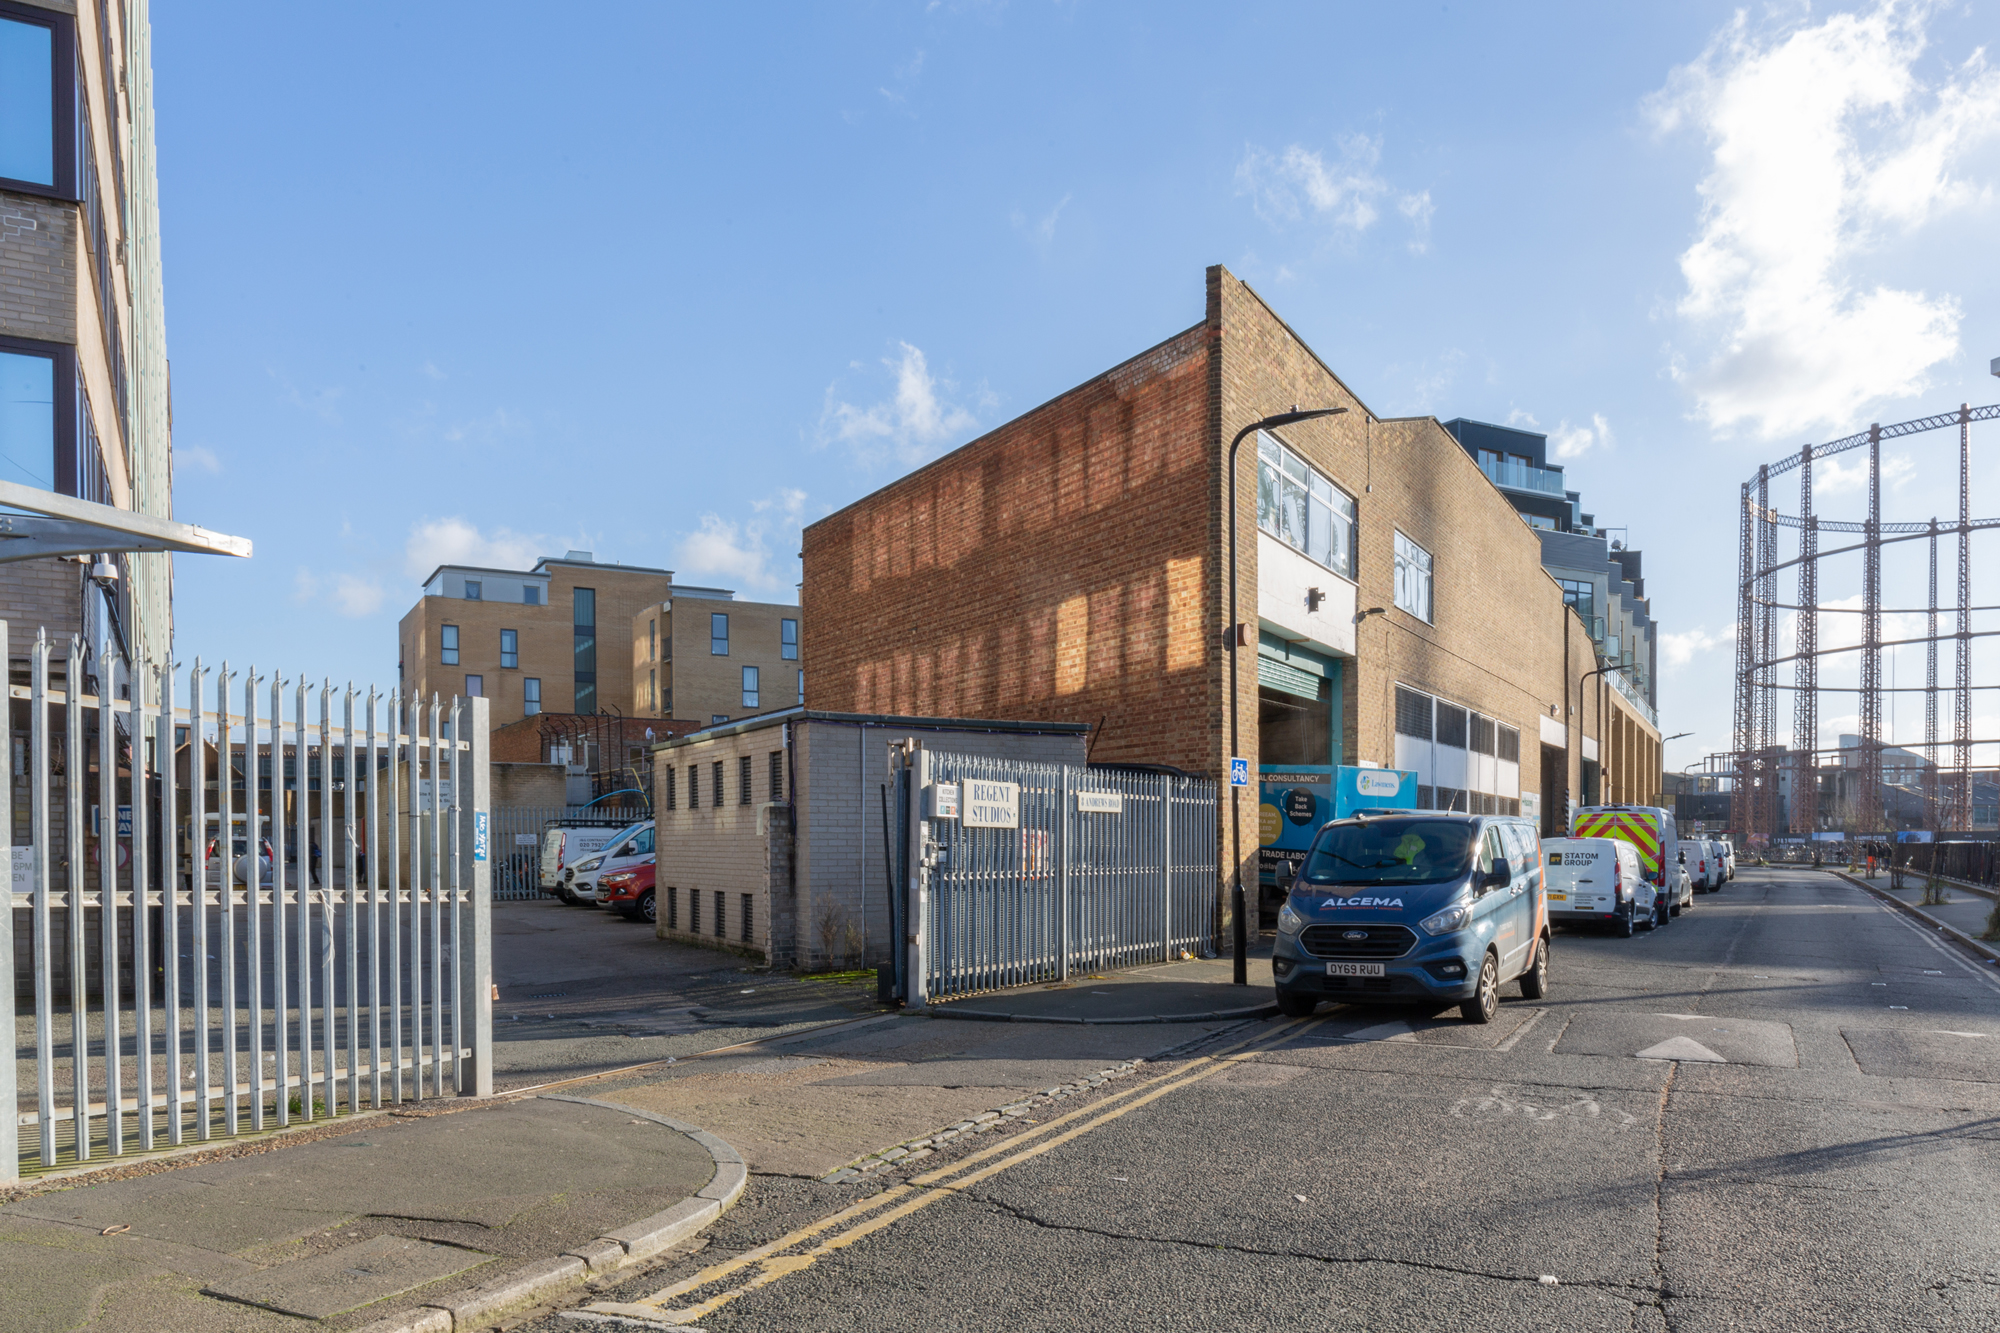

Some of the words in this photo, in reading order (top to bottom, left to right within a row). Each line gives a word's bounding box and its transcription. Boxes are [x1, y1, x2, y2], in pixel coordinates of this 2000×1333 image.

[1268, 774, 1319, 783] CONSULTANCY
[973, 783, 1011, 803] REGENT
[1086, 797, 1107, 808] ANDREWS
[1108, 798, 1120, 808] ROAD
[118, 810, 131, 821] NE
[972, 805, 1012, 824] STUDIOS
[1259, 811, 1277, 819] REEAM,
[1289, 810, 1312, 818] Schemes
[118, 822, 131, 832] AY
[11, 851, 23, 860] BE
[1261, 850, 1285, 859] TRADE
[1286, 852, 1308, 860] LABO
[13, 862, 33, 871] 6PM
[1320, 897, 1404, 907] ALCEMA
[1347, 931, 1362, 939] Ford
[1330, 963, 1357, 974] OY69
[1359, 964, 1380, 975] RUU
